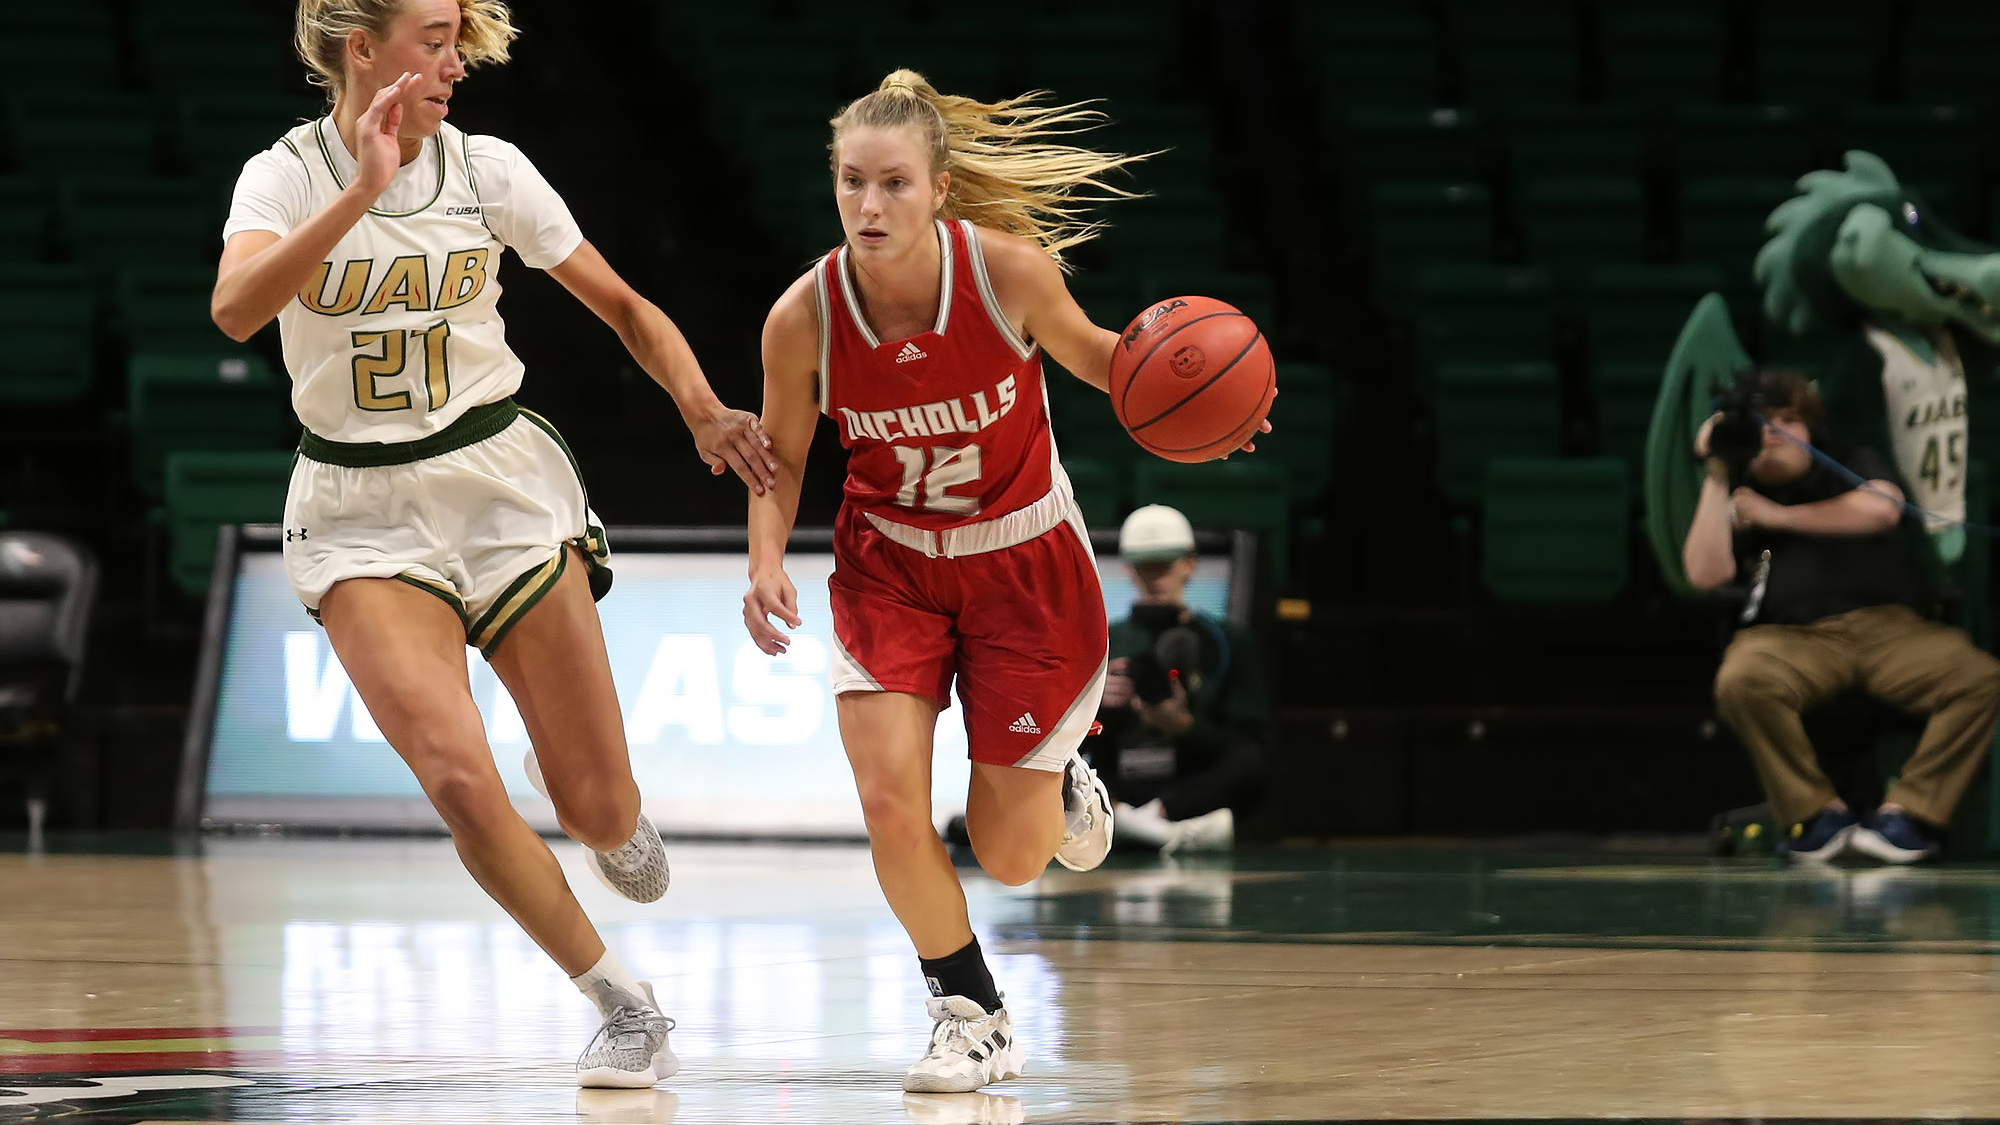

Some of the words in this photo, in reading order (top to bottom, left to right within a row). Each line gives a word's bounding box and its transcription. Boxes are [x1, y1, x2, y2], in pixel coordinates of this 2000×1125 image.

[297, 247, 489, 316] UAB
[895, 351, 928, 364] adidas
[1122, 299, 1189, 352] NCAA
[351, 319, 450, 412] 21
[837, 373, 1017, 442] NICHOLLS
[893, 442, 982, 516] 12
[1008, 724, 1042, 735] adidas
